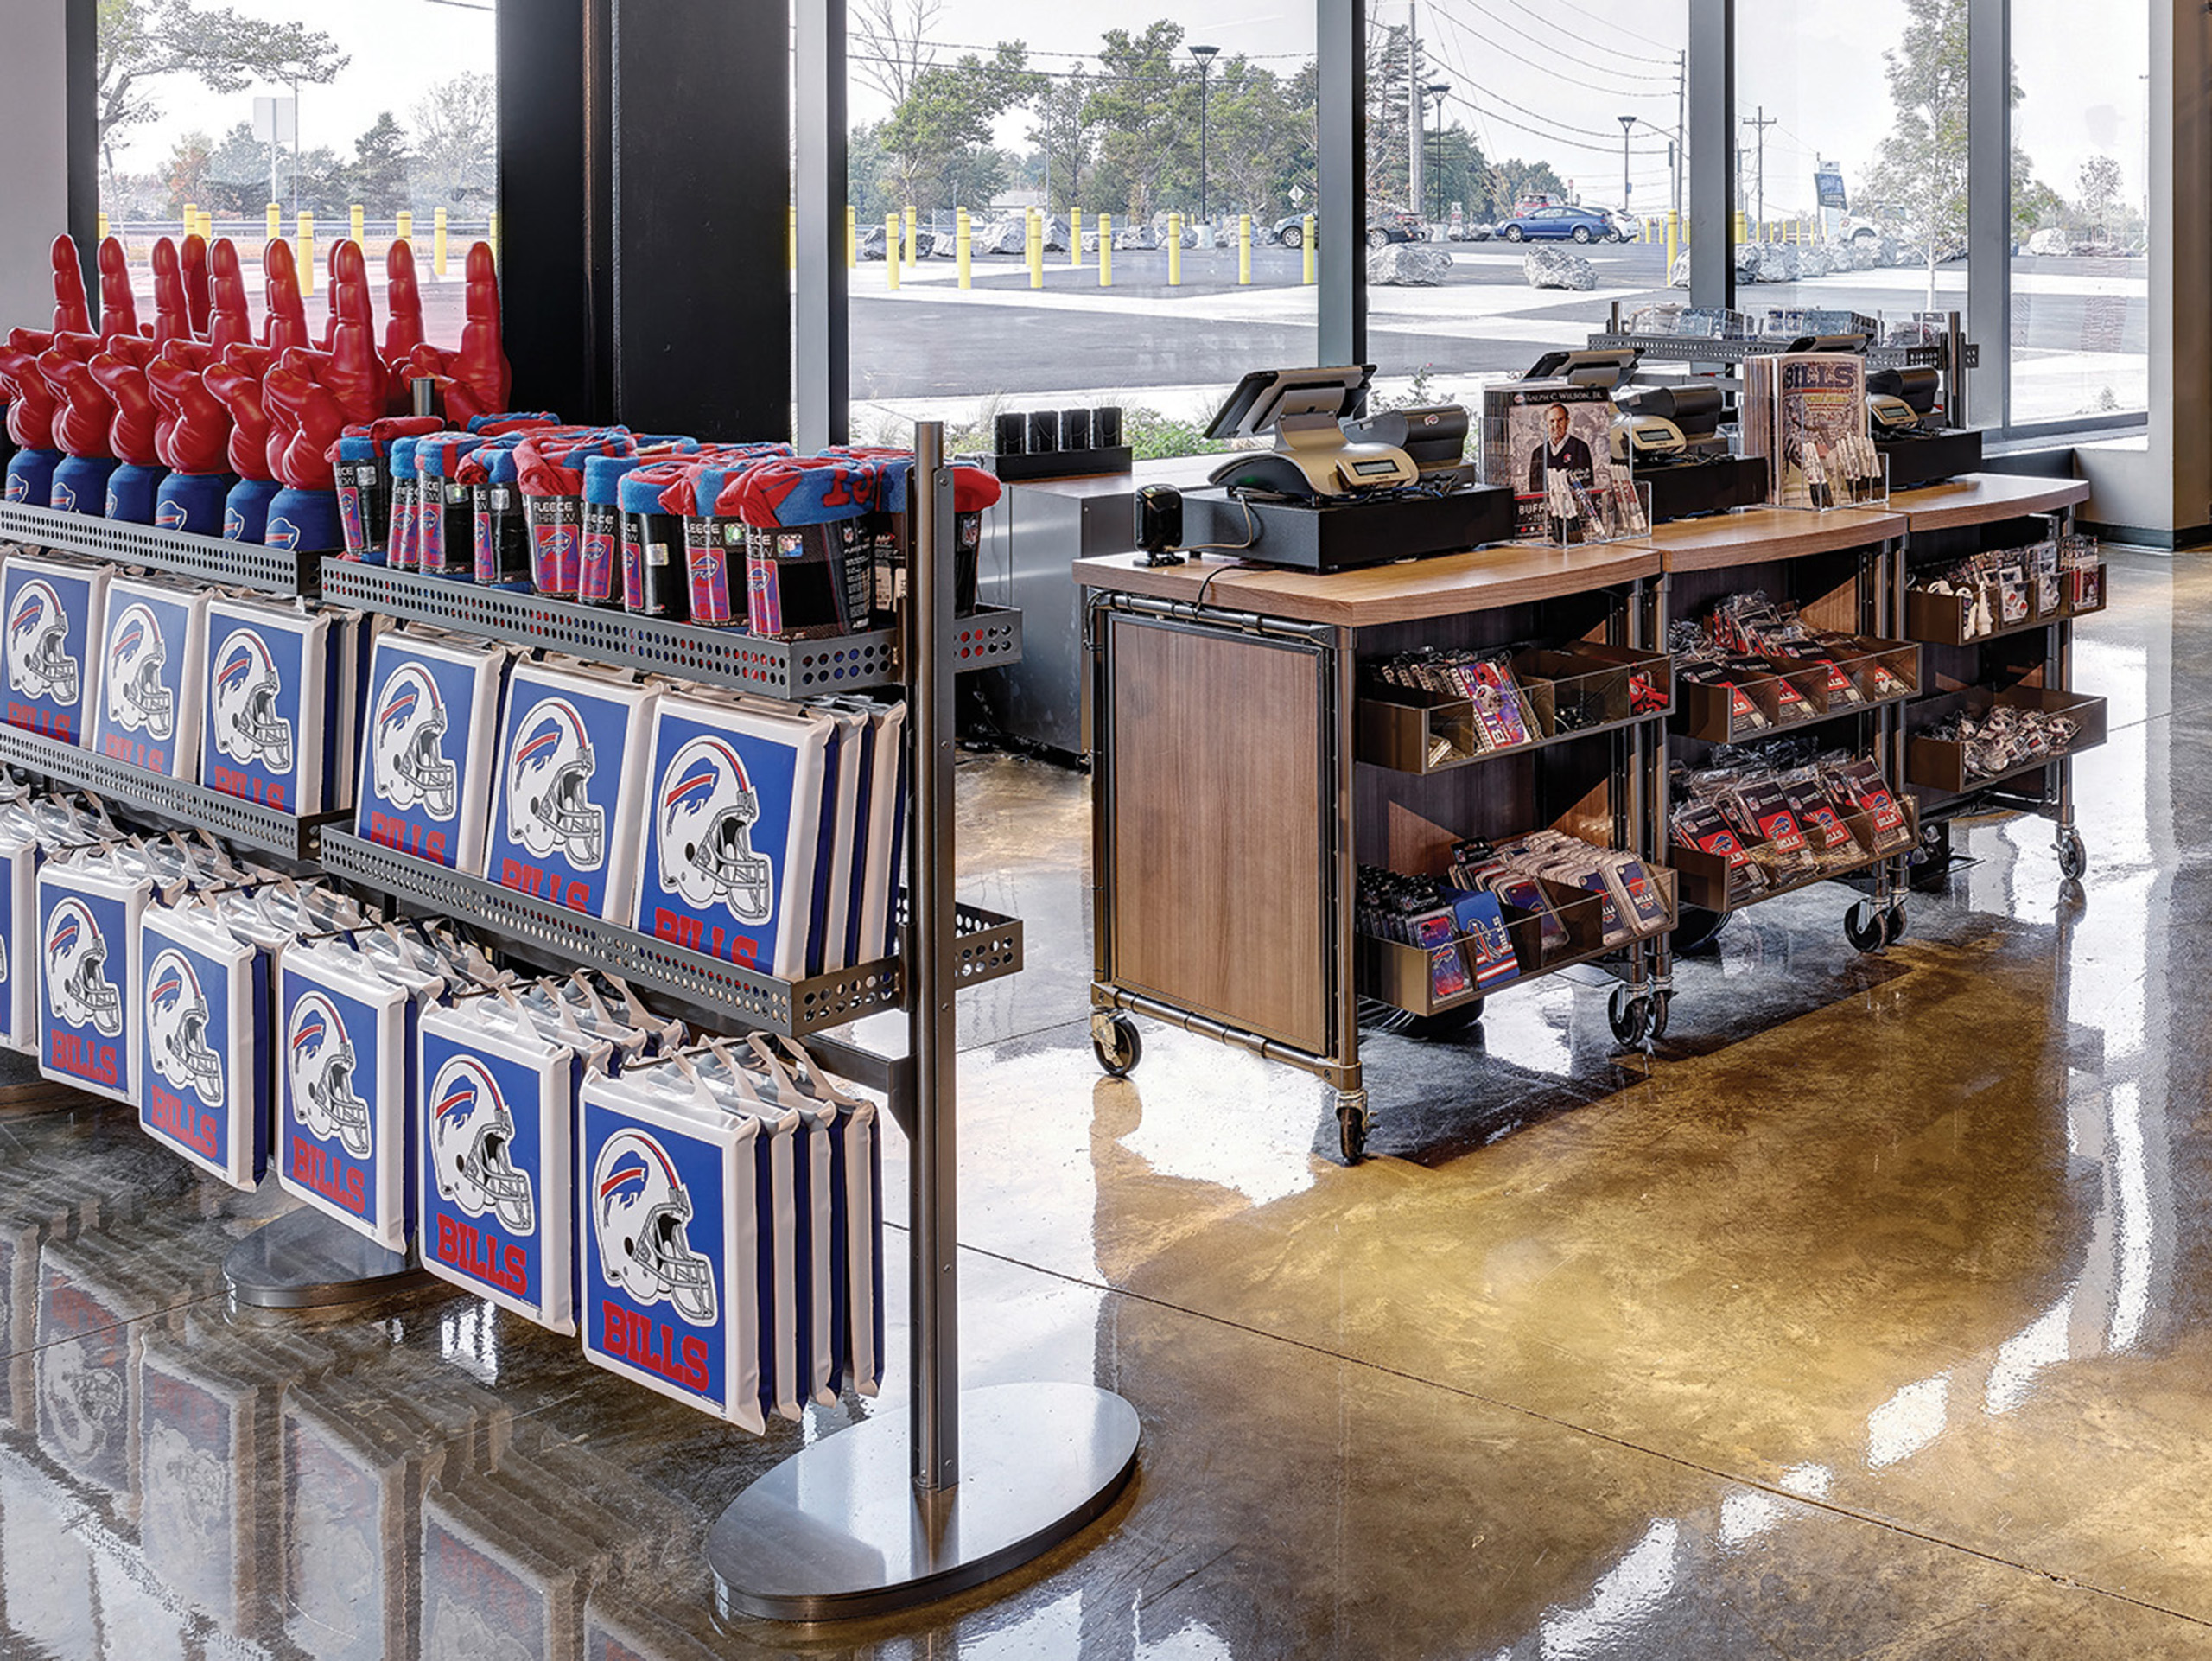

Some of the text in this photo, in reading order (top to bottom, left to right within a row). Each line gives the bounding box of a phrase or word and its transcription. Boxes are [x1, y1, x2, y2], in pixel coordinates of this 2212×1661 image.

[533, 501, 573, 512] FLEECE
[51, 1028, 118, 1085] BILLS
[151, 1084, 218, 1159] BILLS
[292, 1135, 365, 1215] BILLS
[436, 1212, 528, 1296] BILLS
[602, 1299, 709, 1392] BILLS
